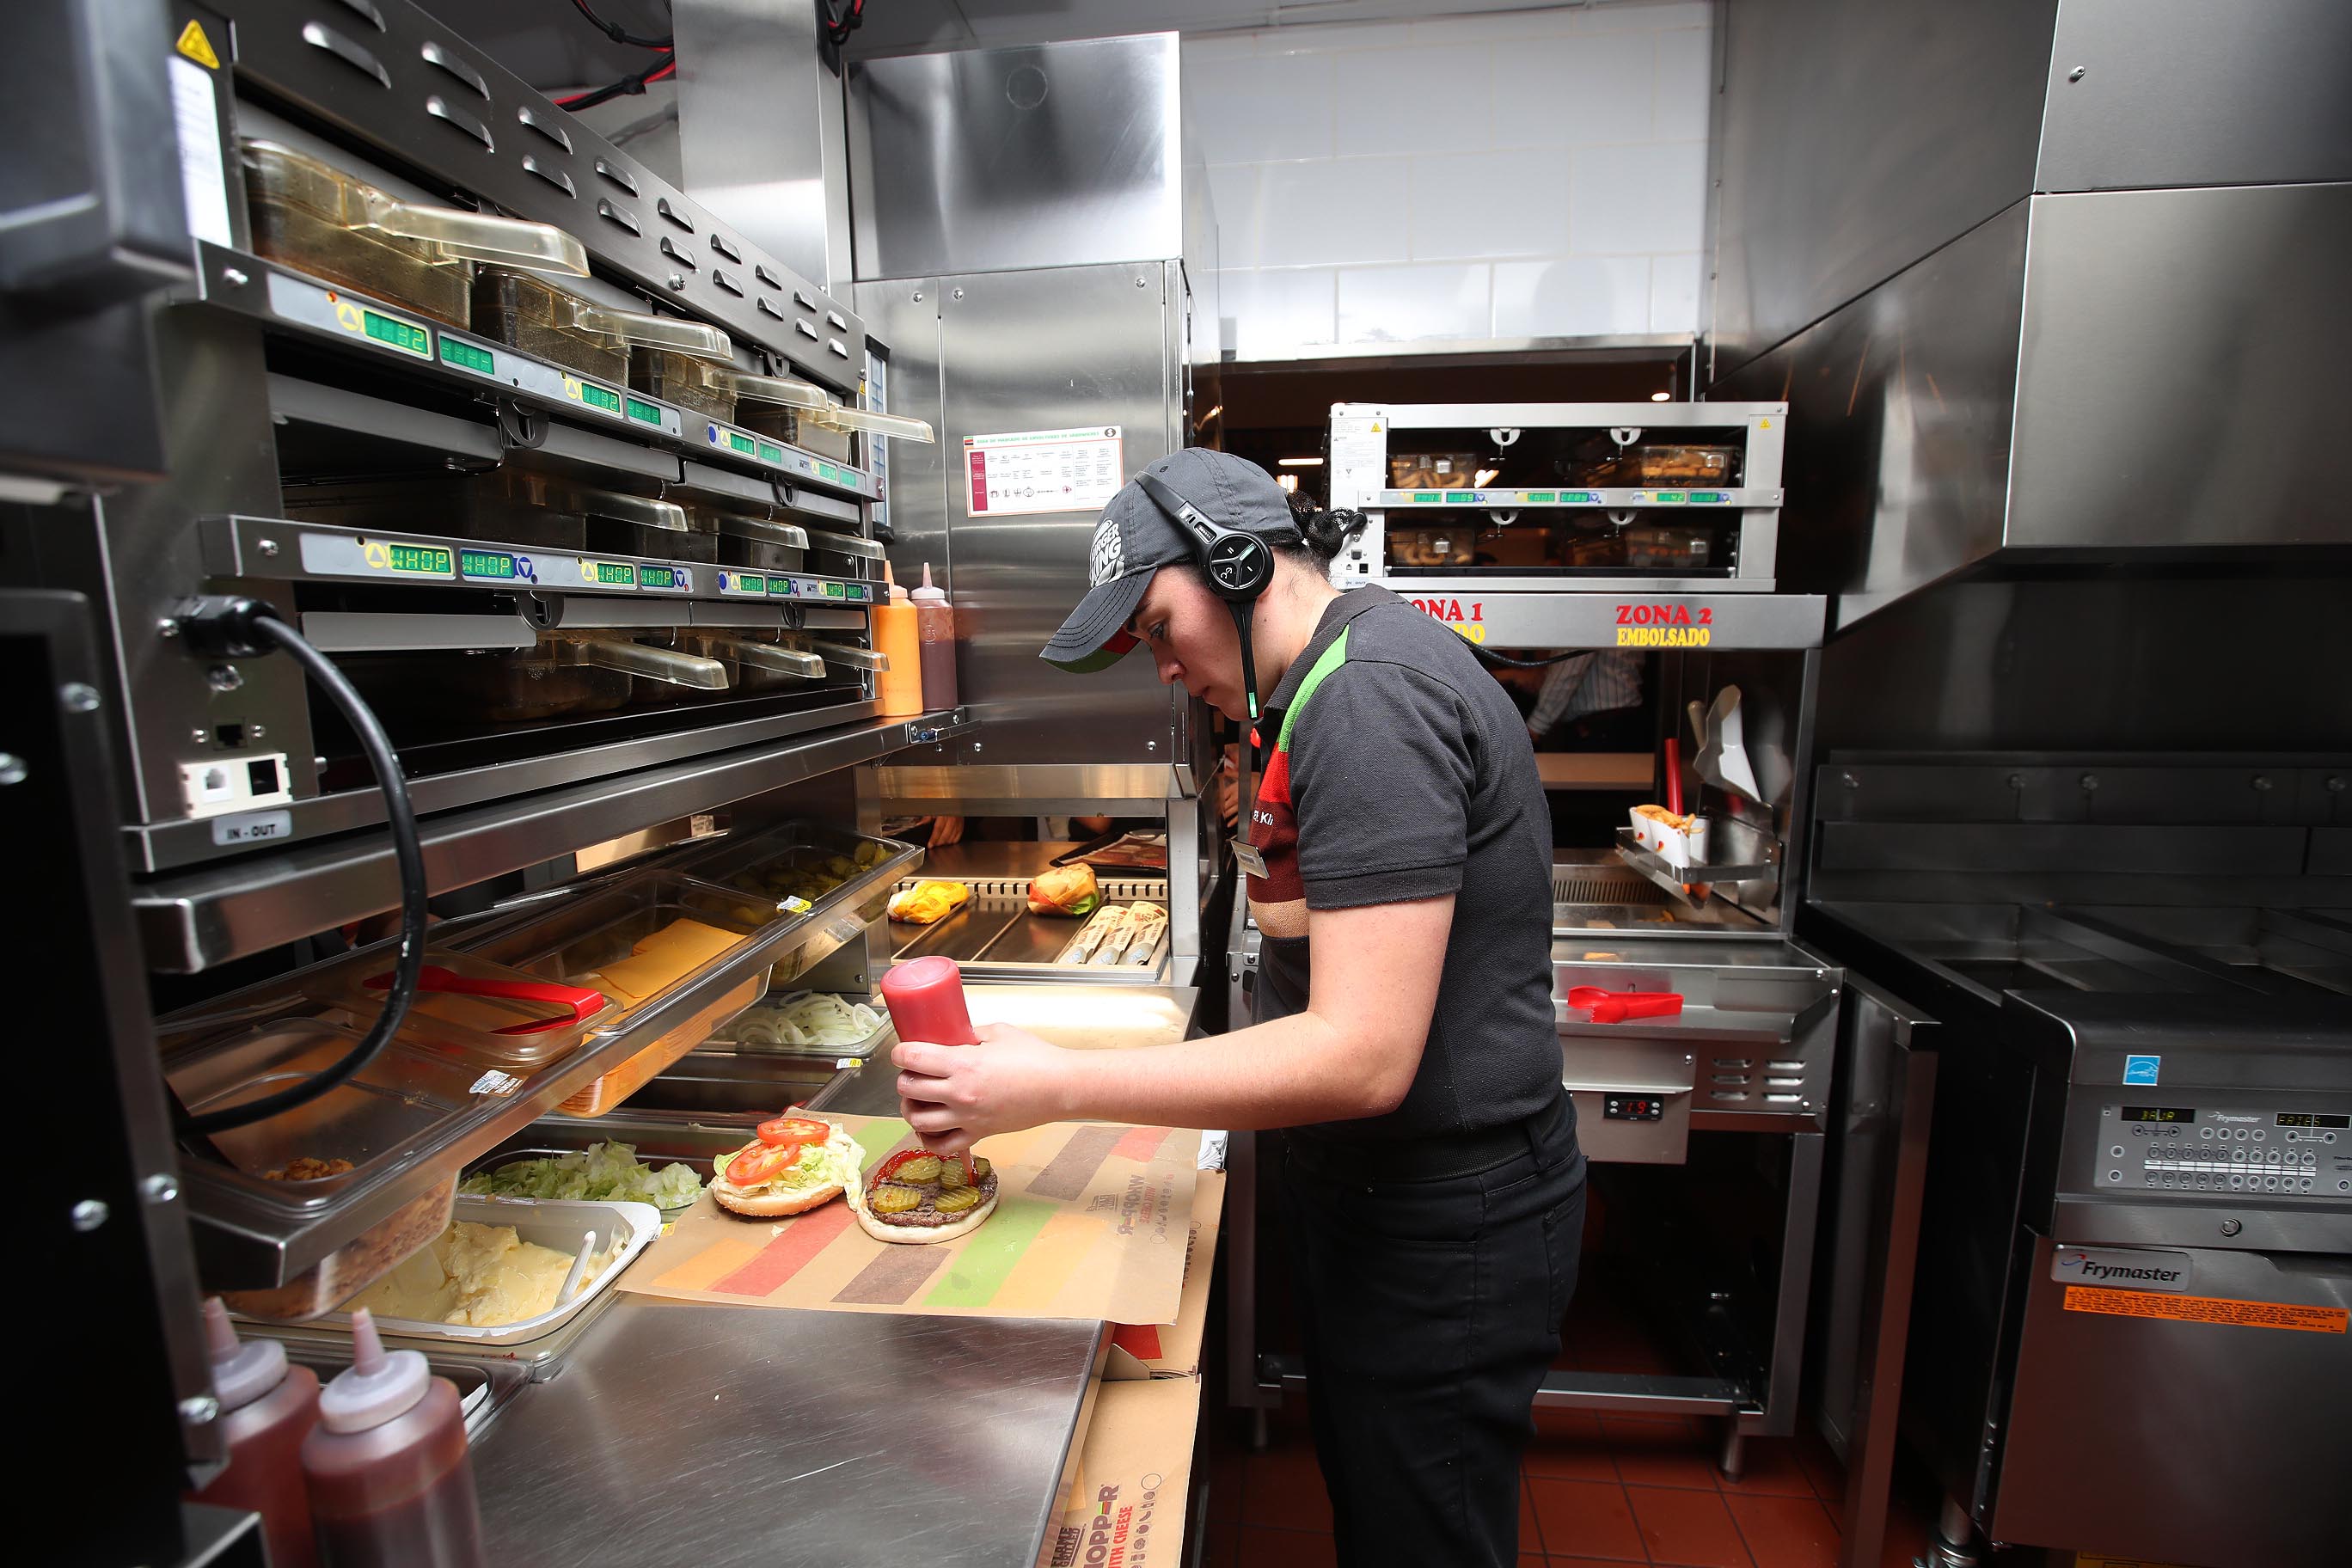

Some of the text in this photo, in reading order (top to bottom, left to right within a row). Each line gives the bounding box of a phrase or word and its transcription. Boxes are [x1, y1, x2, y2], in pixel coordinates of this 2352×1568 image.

[1092, 523, 1119, 566] URGER
[1411, 599, 1484, 622] ONA 1
[1616, 604, 1713, 625] ZONA 2
[1616, 628, 1711, 647] EMBOLSADO
[227, 828, 241, 840] IN
[251, 824, 277, 837] OUT
[2216, 1113, 2262, 1124] Frymaster
[2081, 1261, 2181, 1282] Frymaster
[1083, 1485, 1119, 1568] OPPER
[1112, 1506, 1133, 1545] CHEESE
